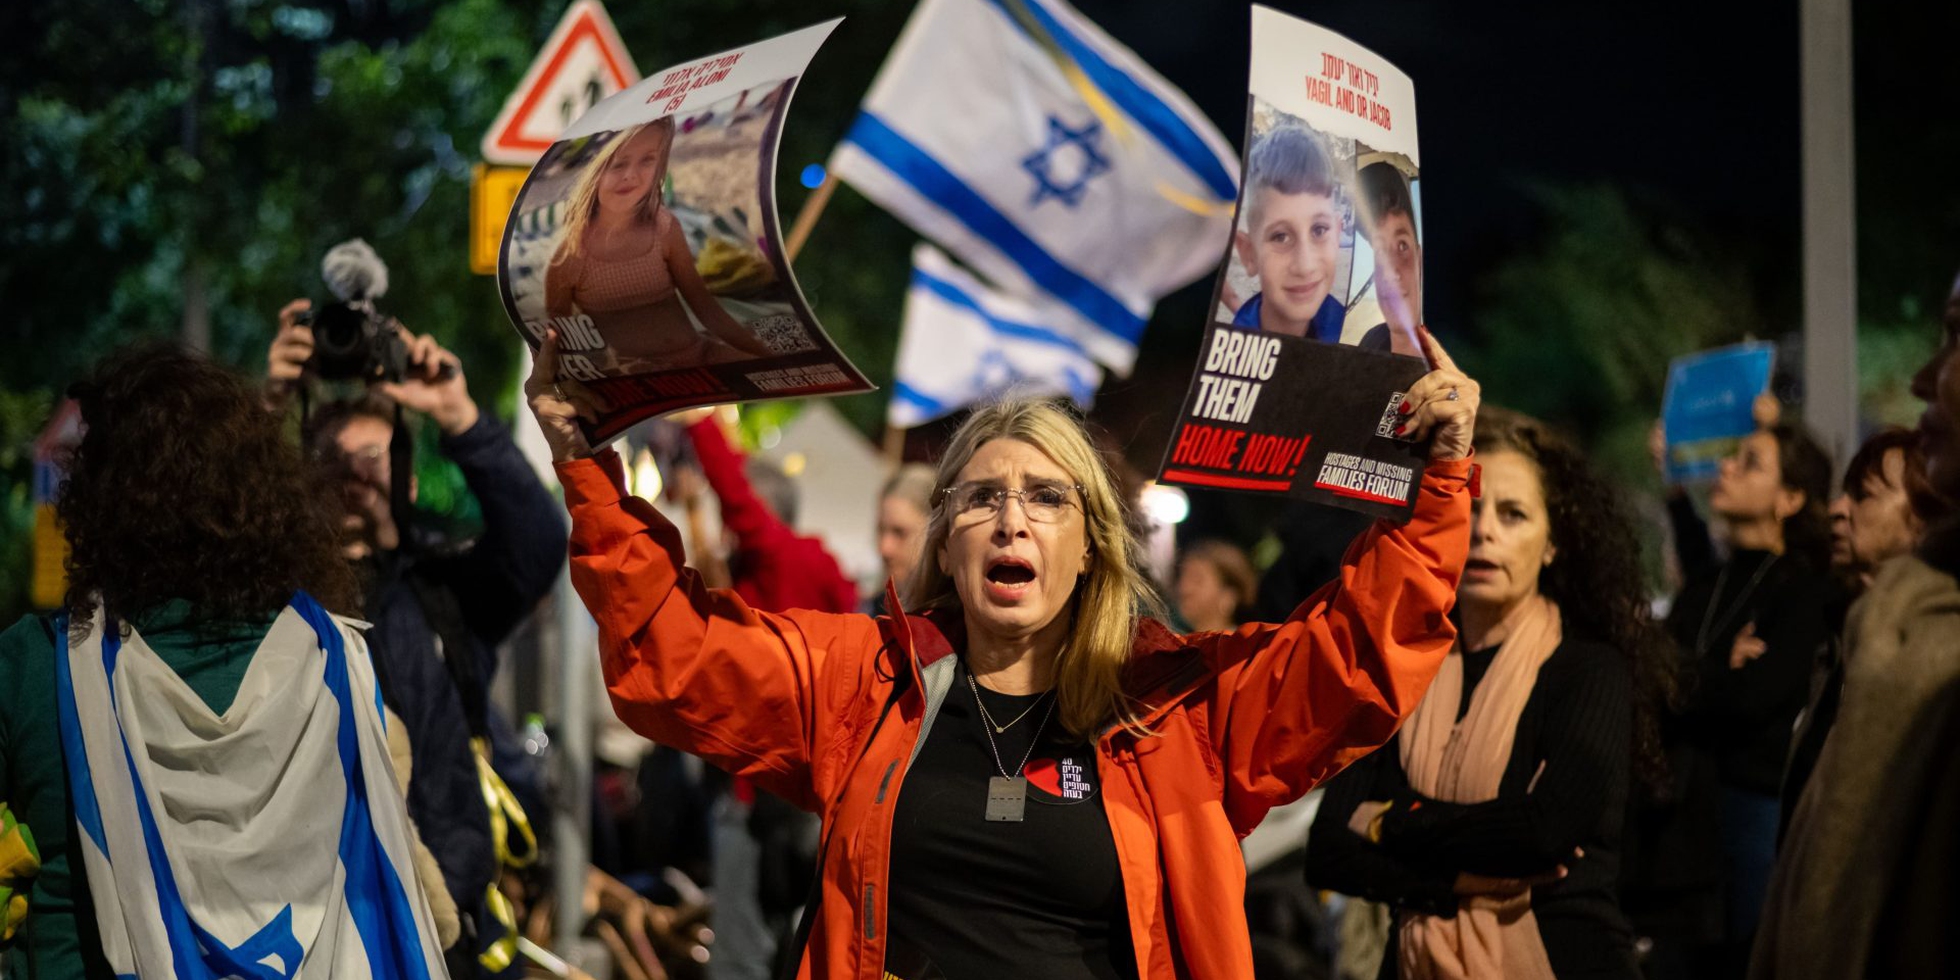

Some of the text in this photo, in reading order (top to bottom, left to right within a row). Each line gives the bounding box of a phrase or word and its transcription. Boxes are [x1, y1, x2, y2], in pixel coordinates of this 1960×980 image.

[1321, 52, 1344, 80] יעקב
[646, 67, 731, 104] EMILIA ALONI
[663, 93, 686, 114] (5)
[1305, 75, 1391, 131] YAGIL AND OR JACOB
[1205, 328, 1282, 381] BRING
[1192, 374, 1262, 424] THEM
[1172, 423, 1312, 477] HOME NOW!
[1324, 452, 1412, 482] HOSTAGES AND MISSING
[1316, 465, 1410, 502] FAMILIES FORUM
[1062, 765, 1082, 774] ילדים
[1063, 773, 1081, 782] עדיין
[1063, 782, 1090, 791] חטופים
[1063, 790, 1083, 799] בעזה
